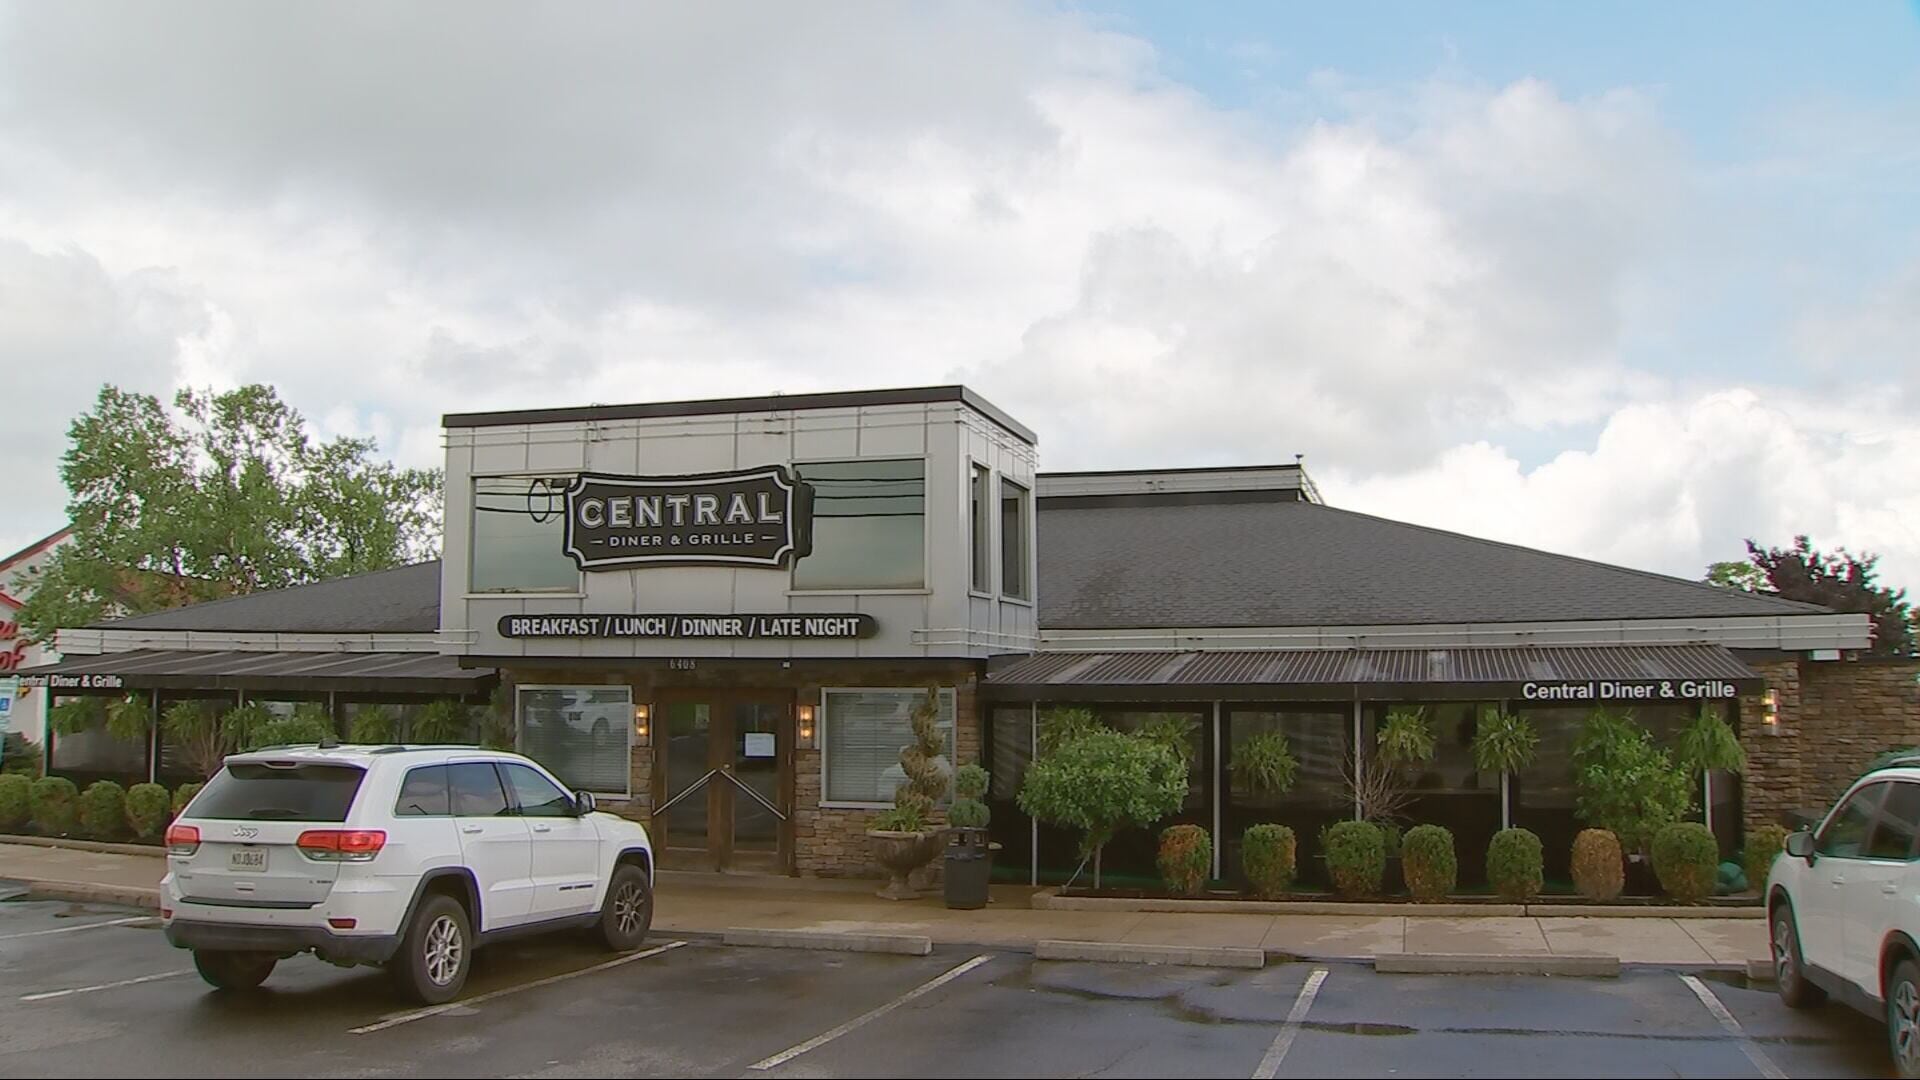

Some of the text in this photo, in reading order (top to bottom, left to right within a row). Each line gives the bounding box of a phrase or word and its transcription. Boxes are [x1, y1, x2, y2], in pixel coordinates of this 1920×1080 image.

[577, 492, 783, 529] CENTRAL
[609, 533, 755, 547] DINER & GRILLE
[511, 616, 860, 638] BREAKFAST / LUNCH / DINNER / LATE NIGHT
[50, 674, 80, 687] Diner
[81, 674, 91, 688] &
[92, 675, 122, 688] Grille
[1522, 681, 1736, 699] Central Diner & Grille
